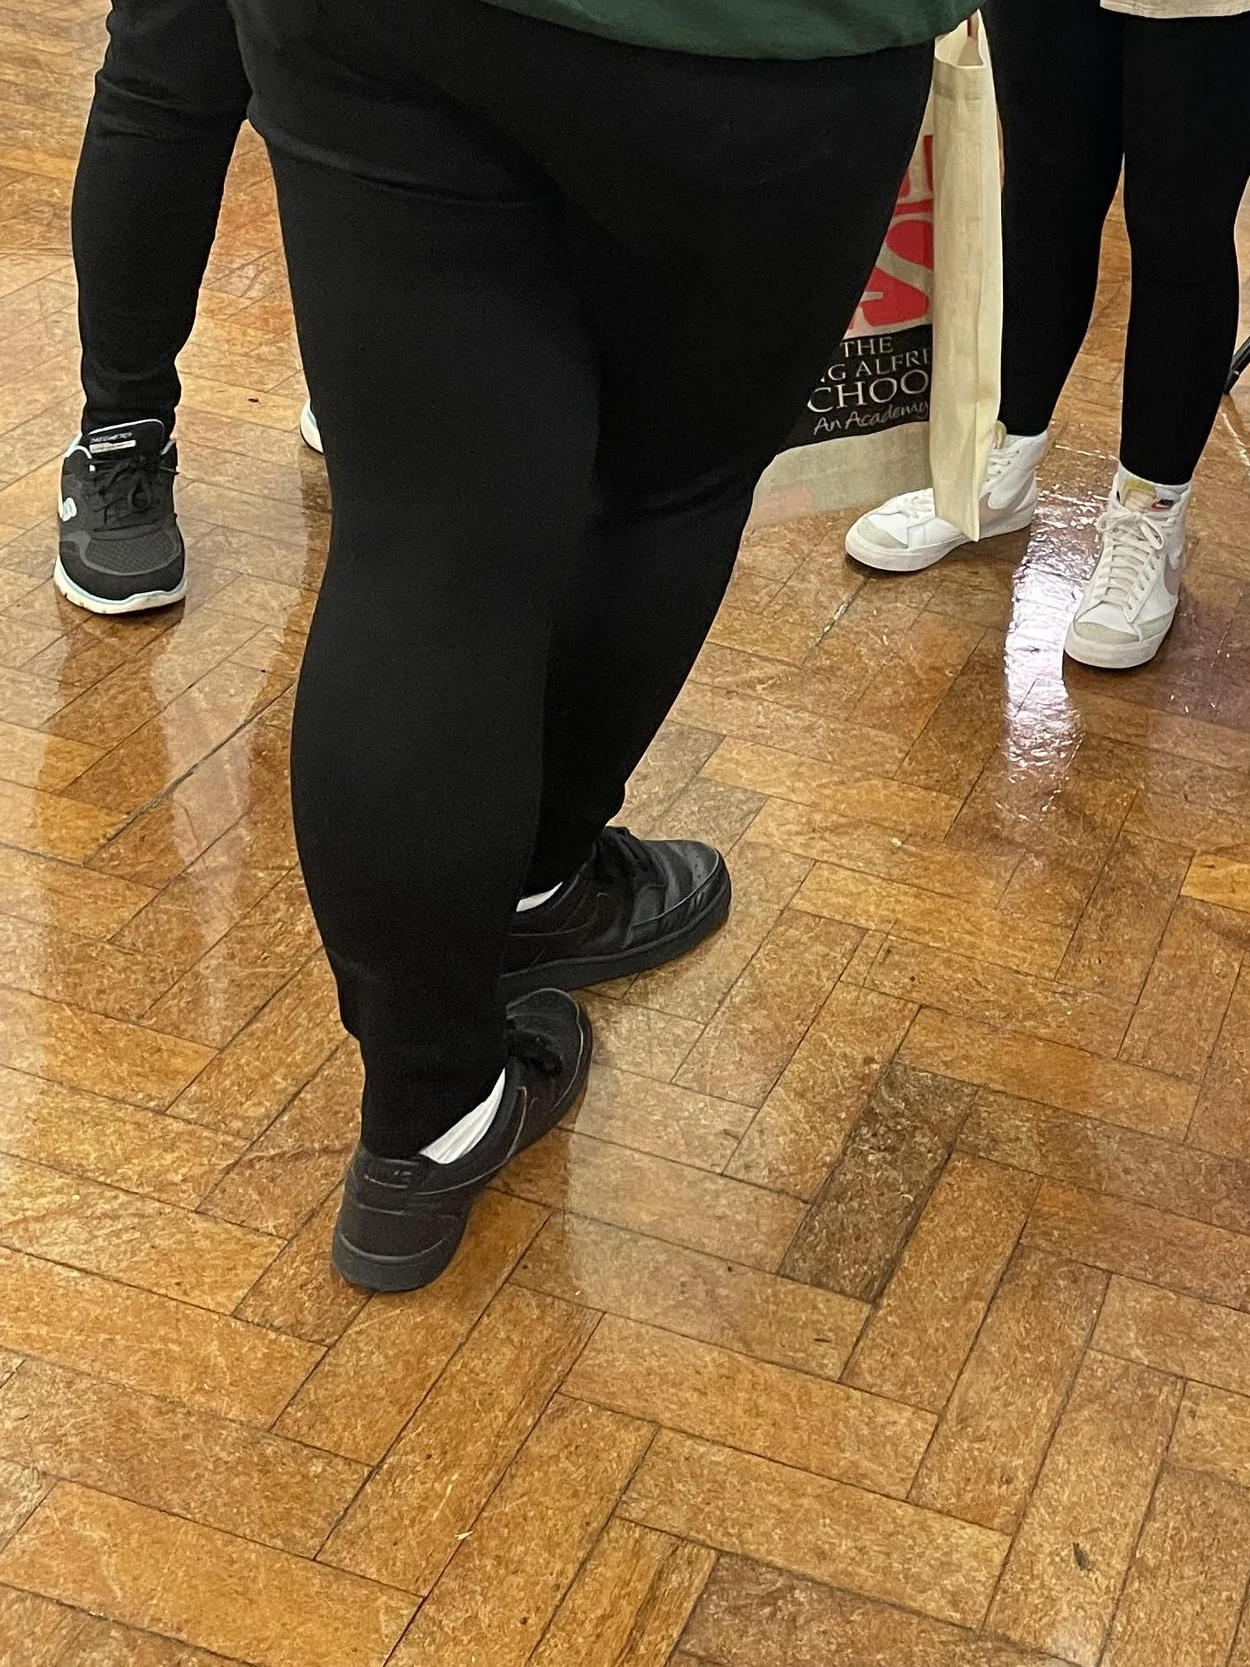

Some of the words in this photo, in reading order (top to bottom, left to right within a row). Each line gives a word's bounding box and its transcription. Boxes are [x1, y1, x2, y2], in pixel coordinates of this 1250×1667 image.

[842, 336, 893, 358] THE
[813, 416, 842, 436] An
[844, 400, 929, 430] Academy
